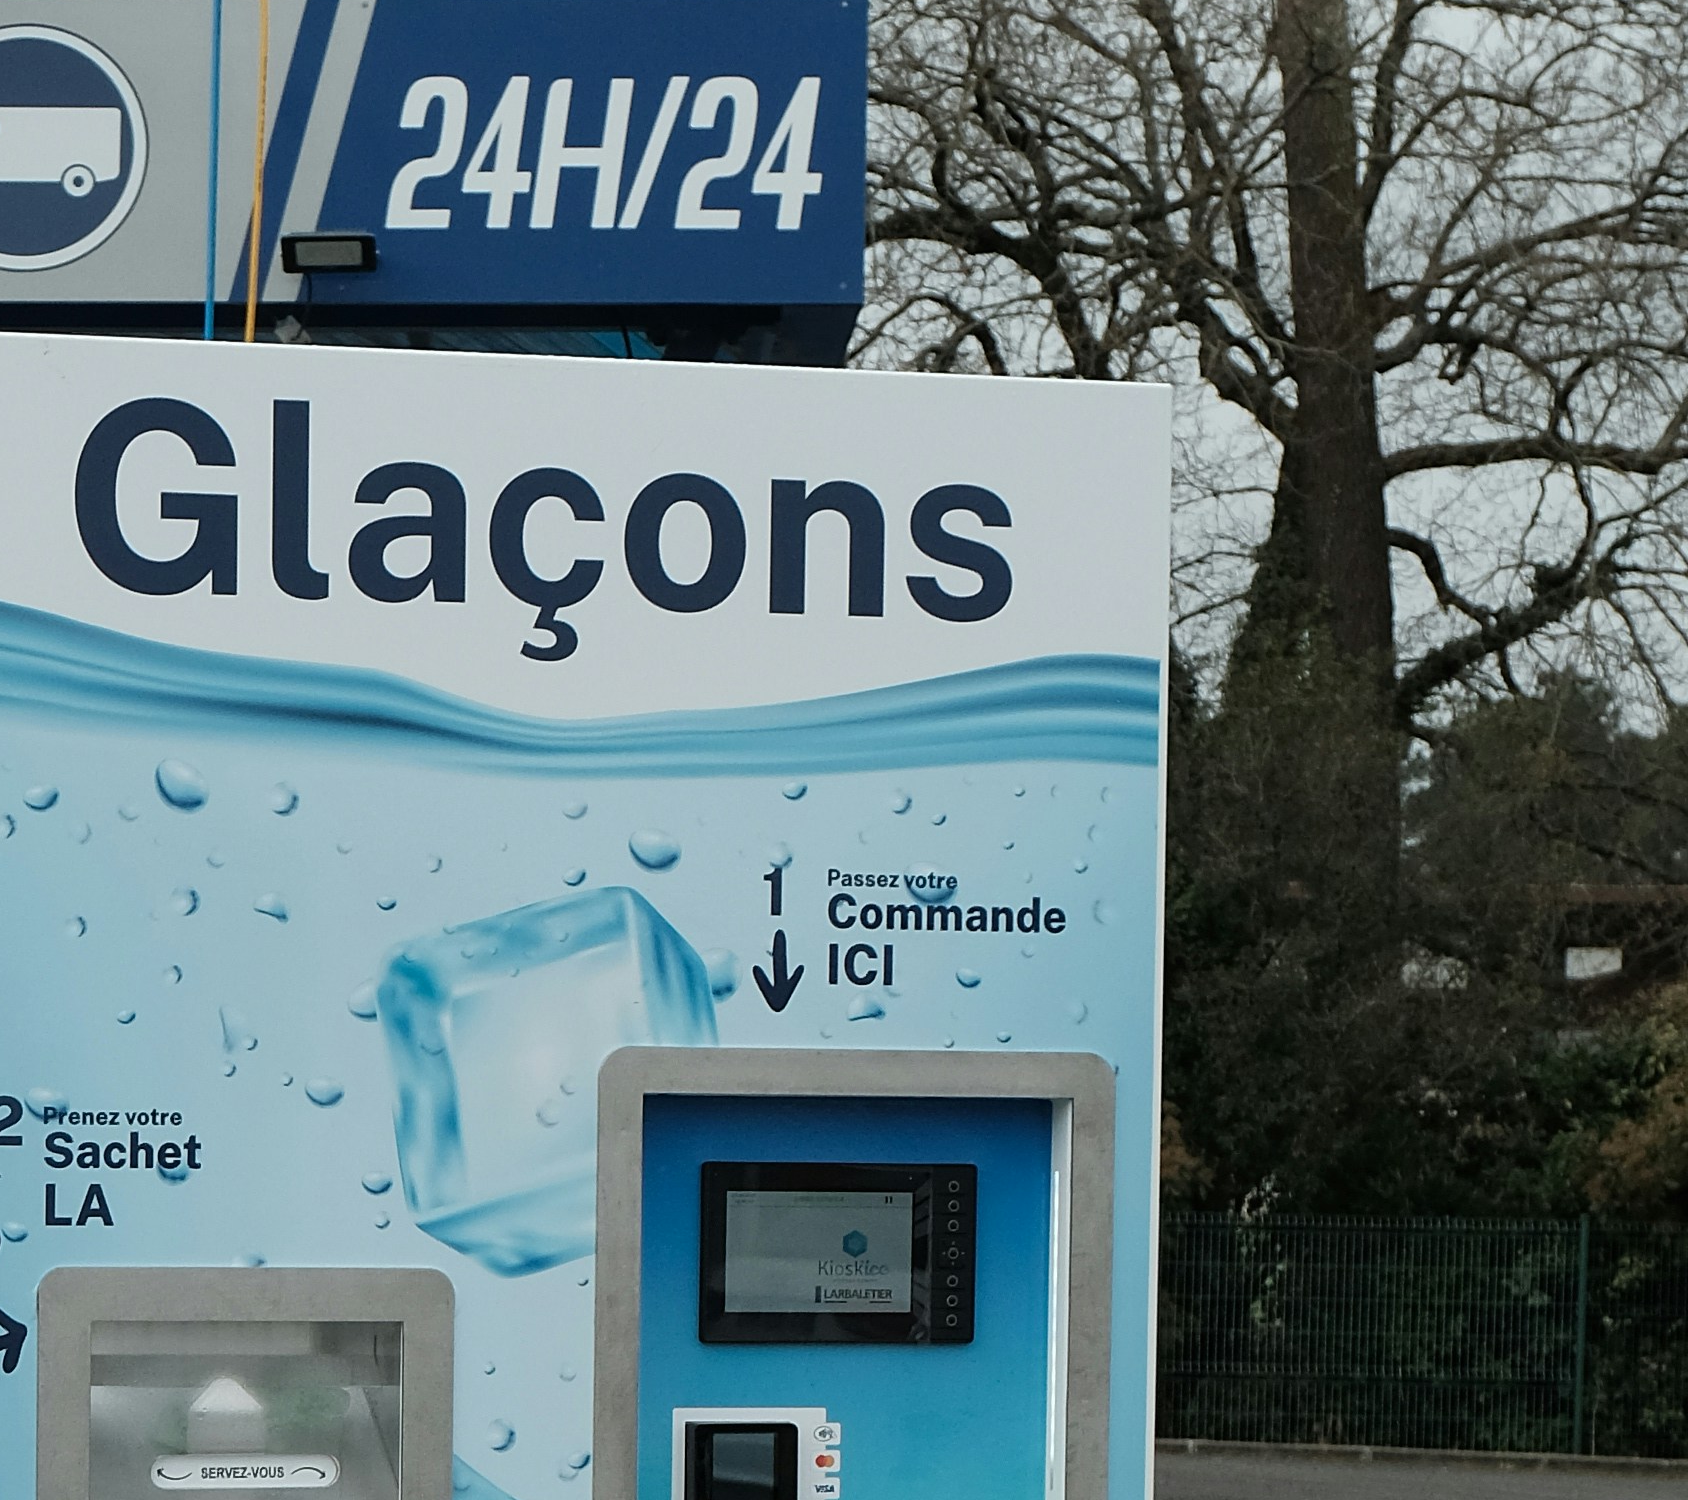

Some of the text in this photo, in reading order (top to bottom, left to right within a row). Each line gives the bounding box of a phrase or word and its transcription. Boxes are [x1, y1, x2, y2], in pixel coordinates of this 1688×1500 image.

[384, 75, 823, 231] 24H/24
[73, 396, 1014, 662] Glaçons
[763, 866, 783, 917] 1
[827, 868, 958, 890] Passez votre
[827, 892, 1067, 934] Commande
[828, 943, 895, 986] ICI
[42, 1105, 183, 1126] Prenez votre
[43, 1131, 202, 1170] Sachet
[45, 1183, 115, 1227] LA
[200, 1466, 285, 1480] SERVEZ-VOUS
